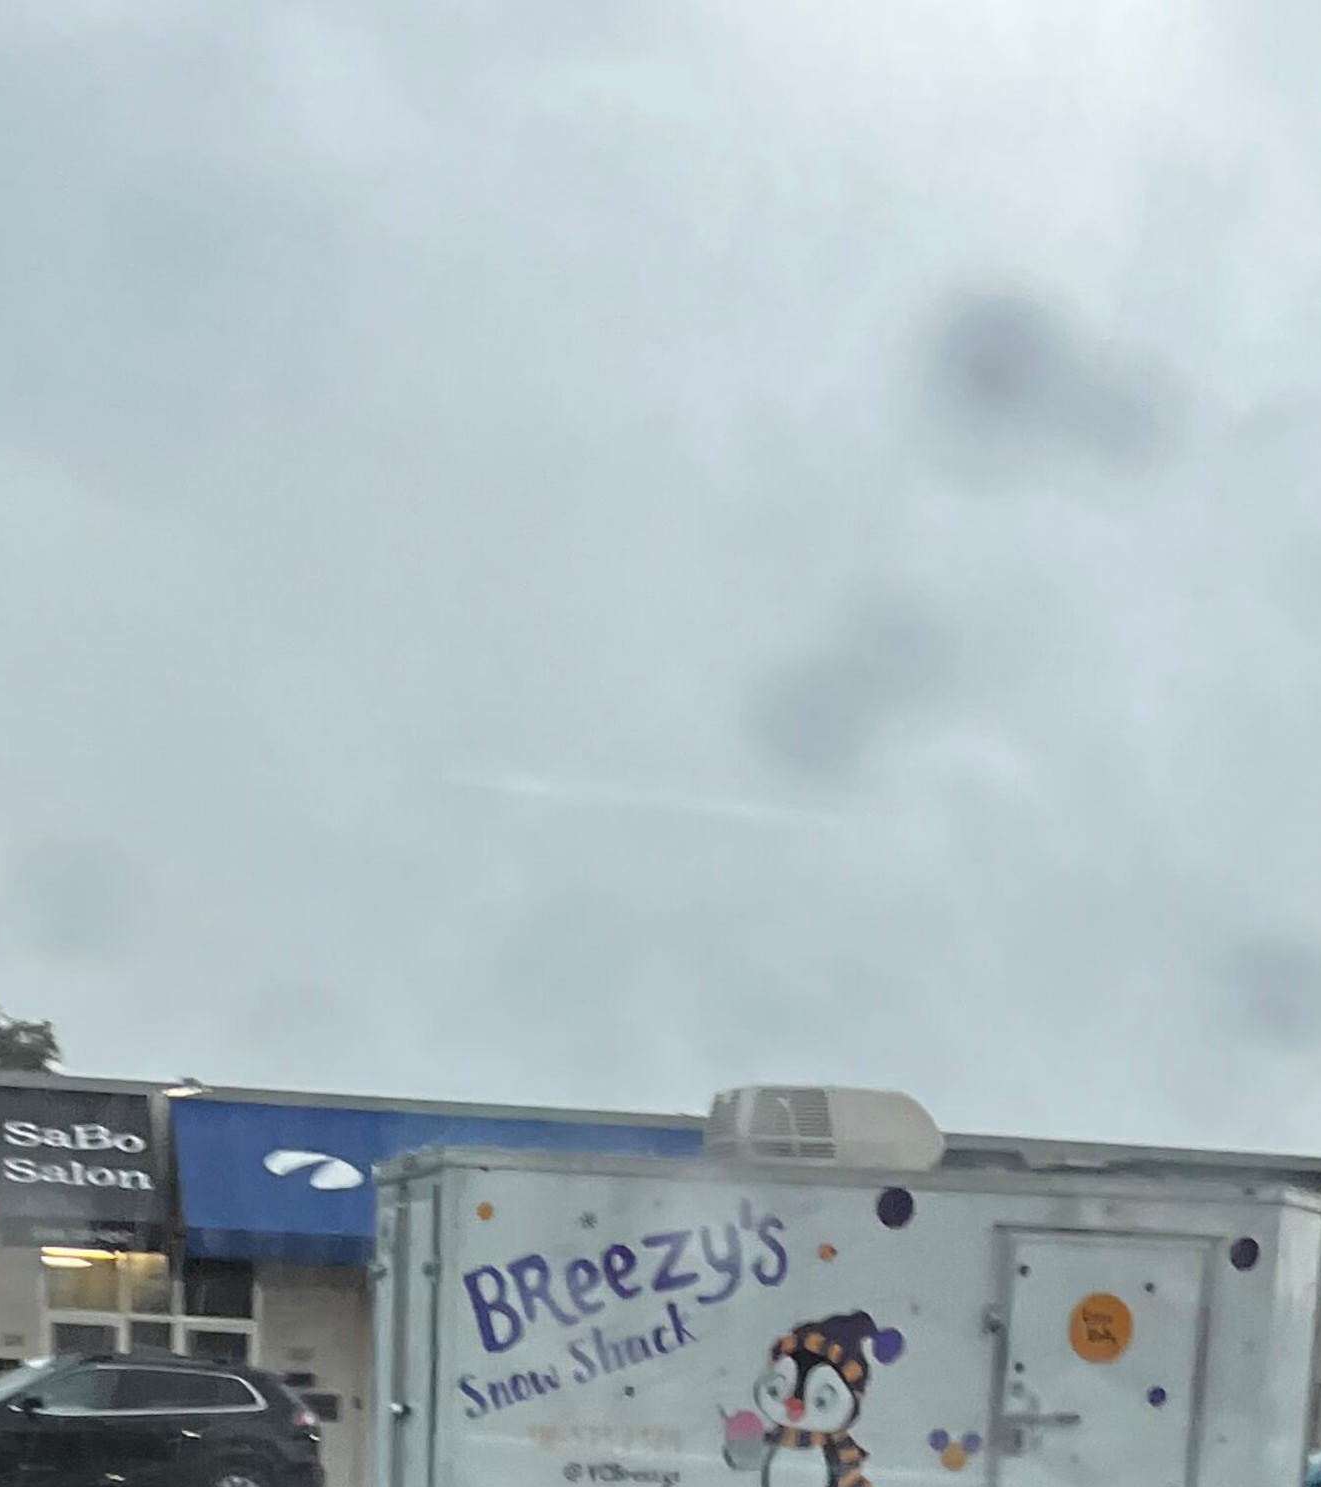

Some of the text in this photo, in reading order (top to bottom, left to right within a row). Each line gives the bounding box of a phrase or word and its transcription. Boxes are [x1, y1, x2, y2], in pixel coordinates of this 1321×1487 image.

[2, 1120, 147, 1154] SaBo
[1, 1157, 155, 1191] Salon
[458, 1300, 699, 1420] Snow Shack
